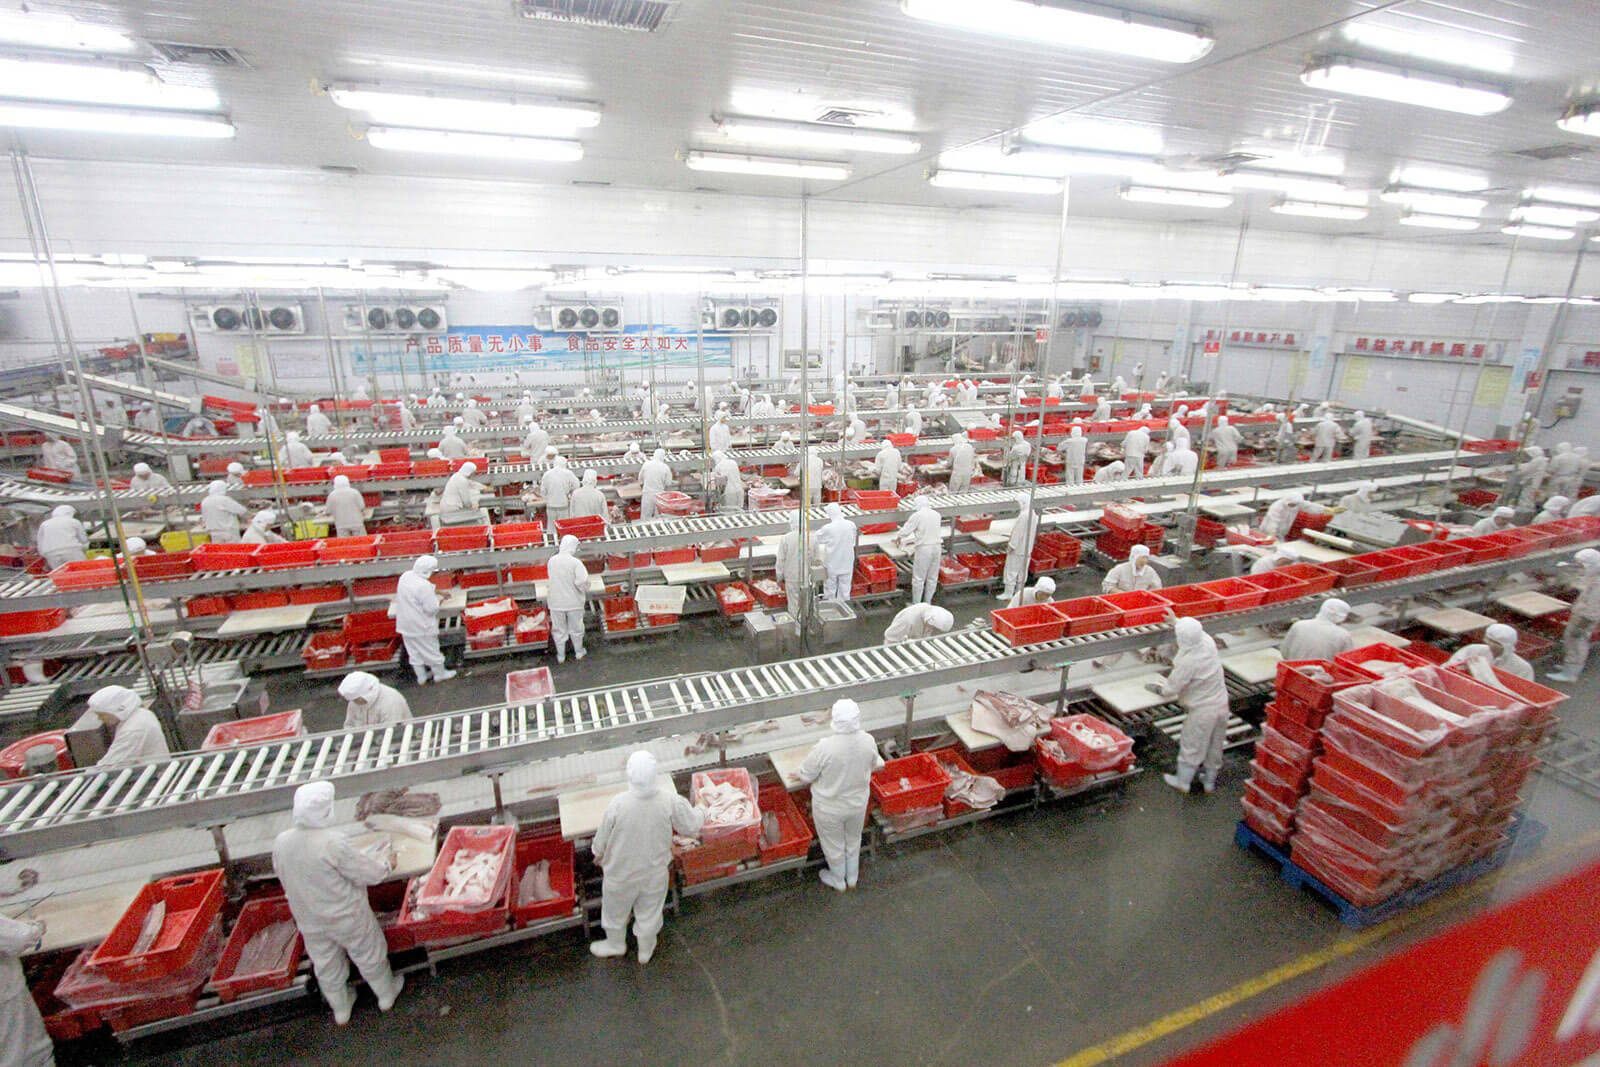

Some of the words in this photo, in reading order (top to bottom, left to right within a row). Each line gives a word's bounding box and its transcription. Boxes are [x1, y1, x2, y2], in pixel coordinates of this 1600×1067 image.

[406, 334, 543, 354] 产品质量无小事
